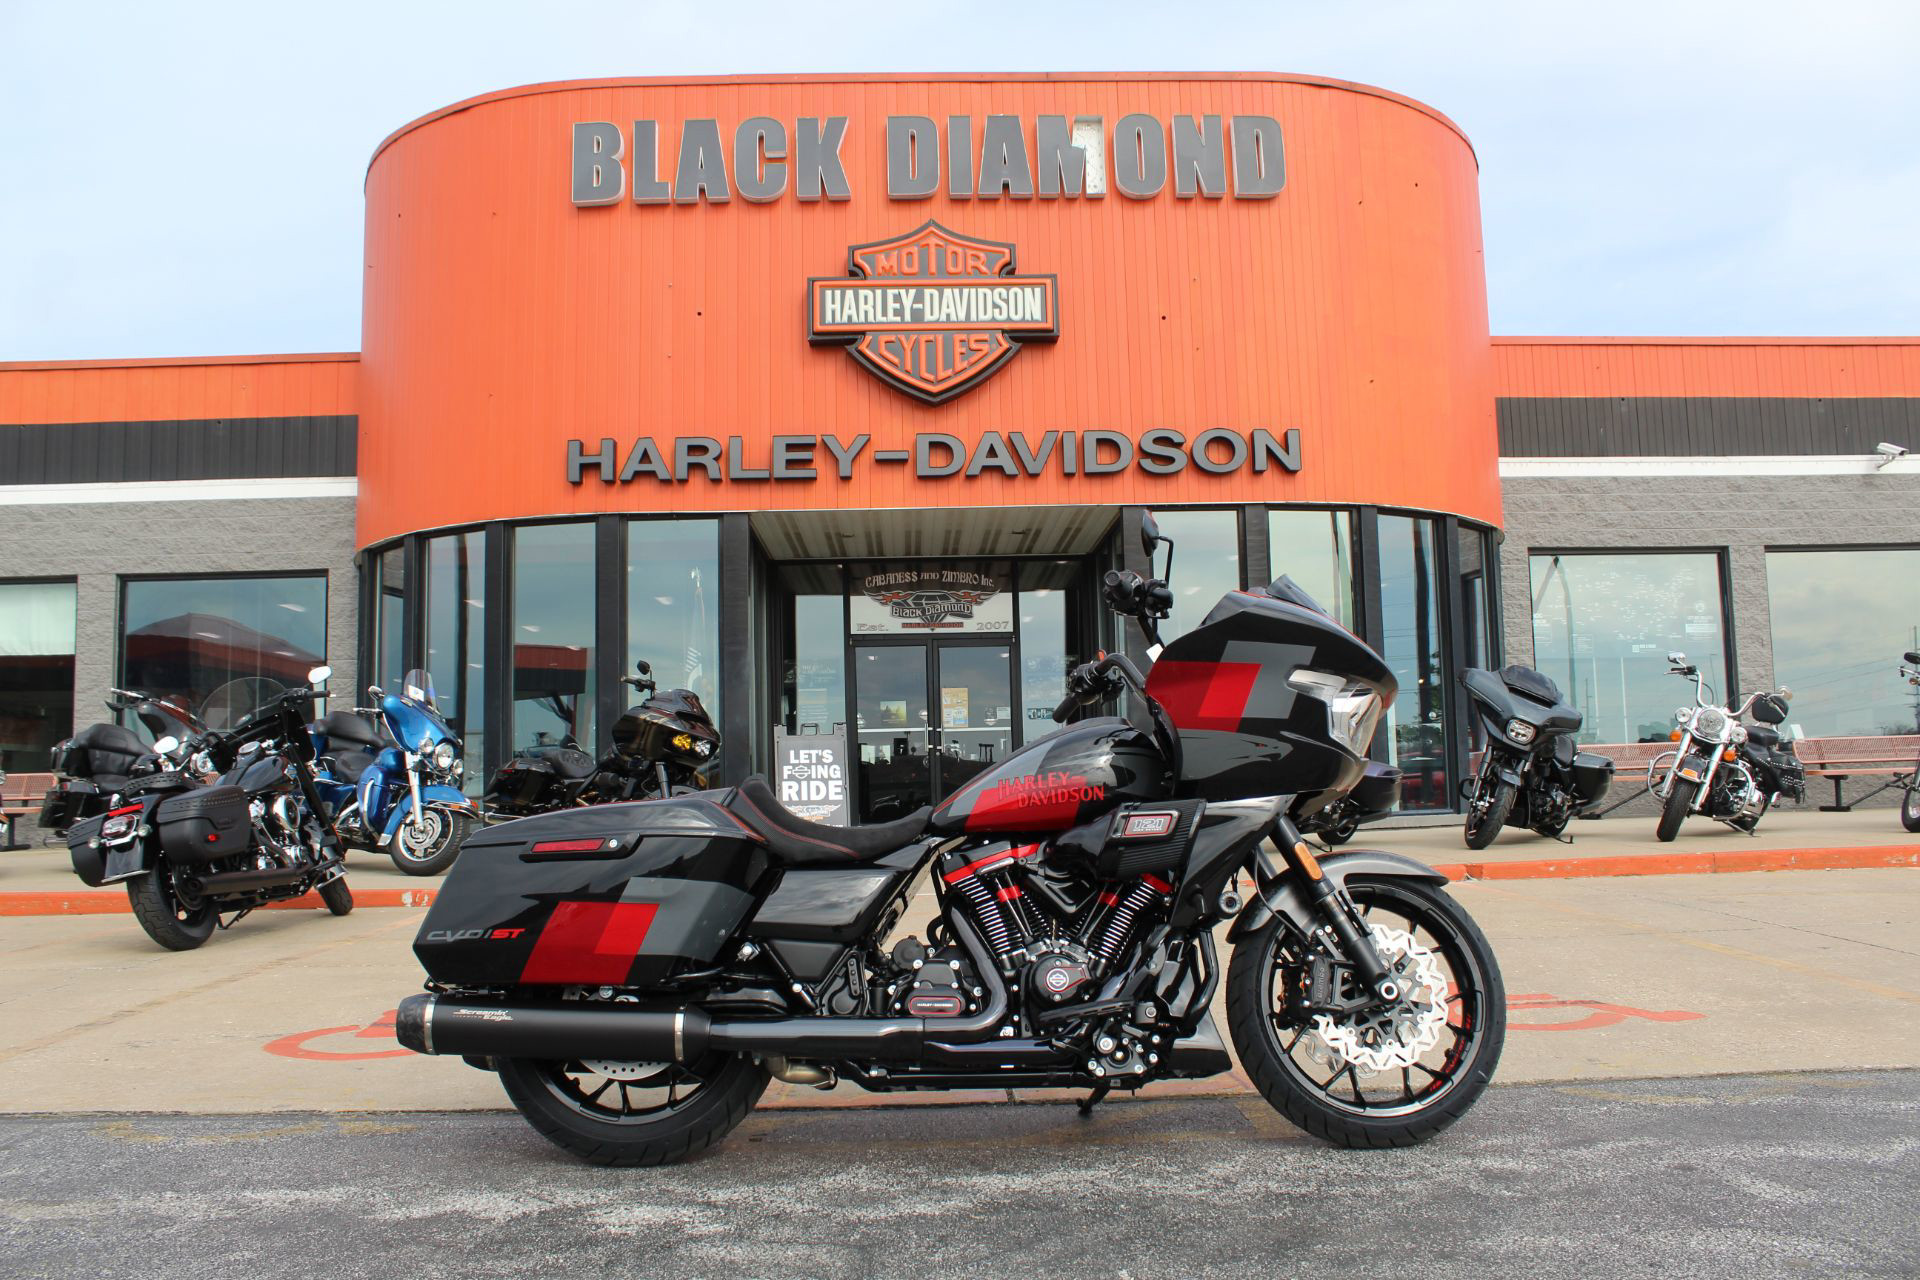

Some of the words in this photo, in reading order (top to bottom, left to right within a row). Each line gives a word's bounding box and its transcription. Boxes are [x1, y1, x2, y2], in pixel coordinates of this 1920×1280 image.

[571, 115, 852, 207] BLACK
[886, 113, 1287, 200] DIAMOND
[876, 240, 989, 276] MOTOR
[824, 285, 1043, 325] HARLEY-DAVIDSON
[877, 332, 993, 384] CYCLES
[567, 428, 1302, 485] HARLEY-DAVIDSON
[865, 571, 918, 588] CABANESS
[942, 570, 979, 585] ZIMBRO
[981, 574, 995, 587] Inc.
[856, 623, 889, 632] Est.
[976, 621, 1010, 631] 2007
[789, 749, 833, 764] LET'S
[782, 780, 843, 801] RIDE
[1018, 785, 1105, 808] DAVIDSON
[1135, 818, 1164, 829] 121
